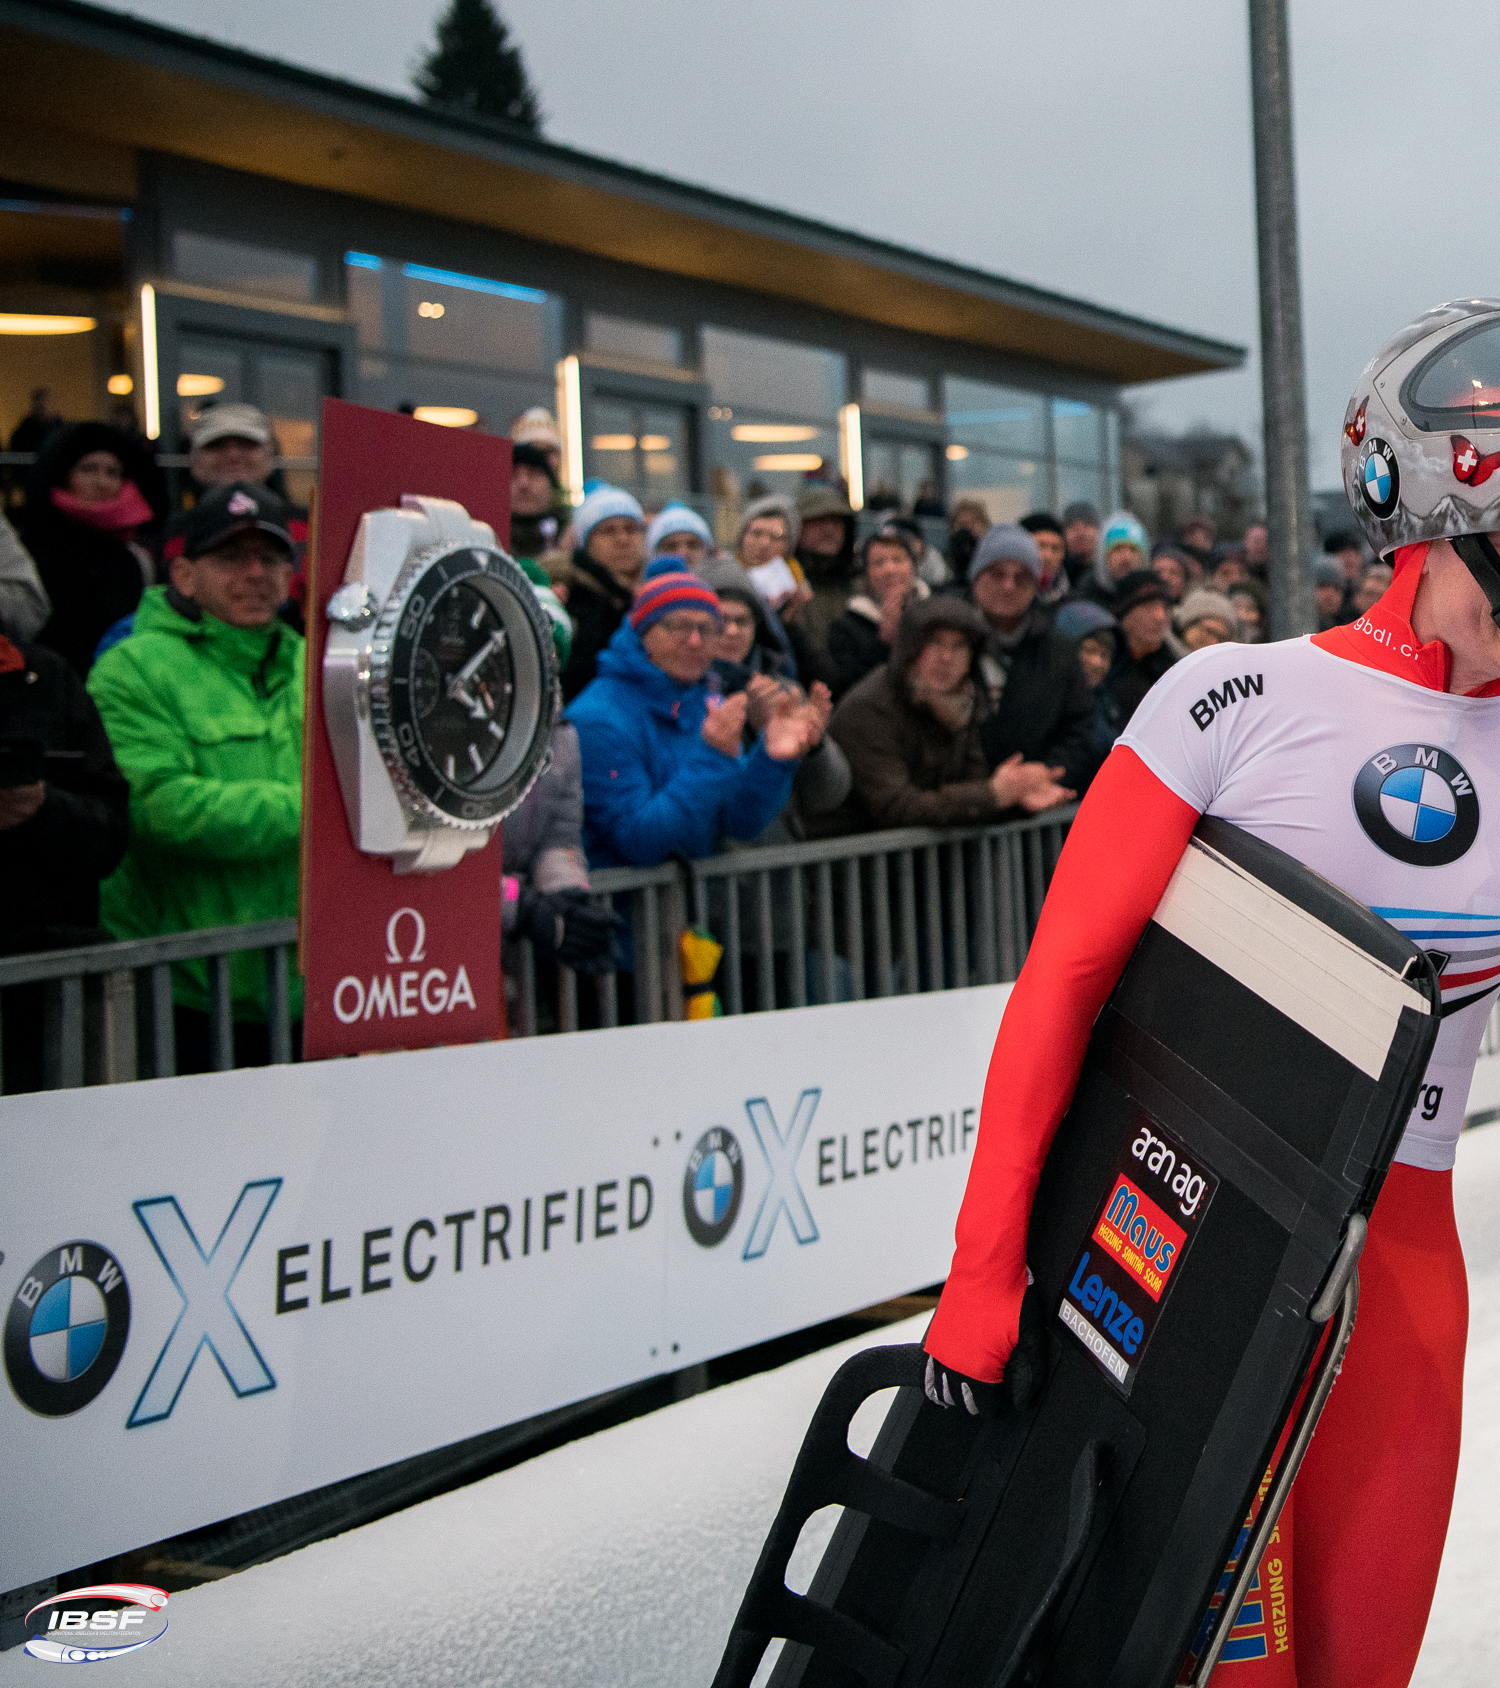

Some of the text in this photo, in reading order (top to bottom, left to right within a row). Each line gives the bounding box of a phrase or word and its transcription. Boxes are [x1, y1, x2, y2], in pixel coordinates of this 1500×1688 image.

[1359, 440, 1393, 470] BMW
[402, 594, 426, 640] 50
[1189, 673, 1264, 732] BMW
[1371, 747, 1473, 797] BMW
[333, 965, 477, 1024] OMEGA
[690, 1131, 740, 1172] BMW
[817, 1107, 976, 1188] ELECTRIF
[18, 1246, 123, 1309] BMW
[275, 1174, 654, 1316] ELECTRIFIED
[1098, 1222, 1123, 1252] HEIZUNG
[1143, 1267, 1163, 1293] SOLAR
[1068, 1251, 1144, 1355] Lenze
[1062, 1304, 1126, 1378] BACHOFEN
[1268, 1558, 1289, 1653] HEIZUNG
